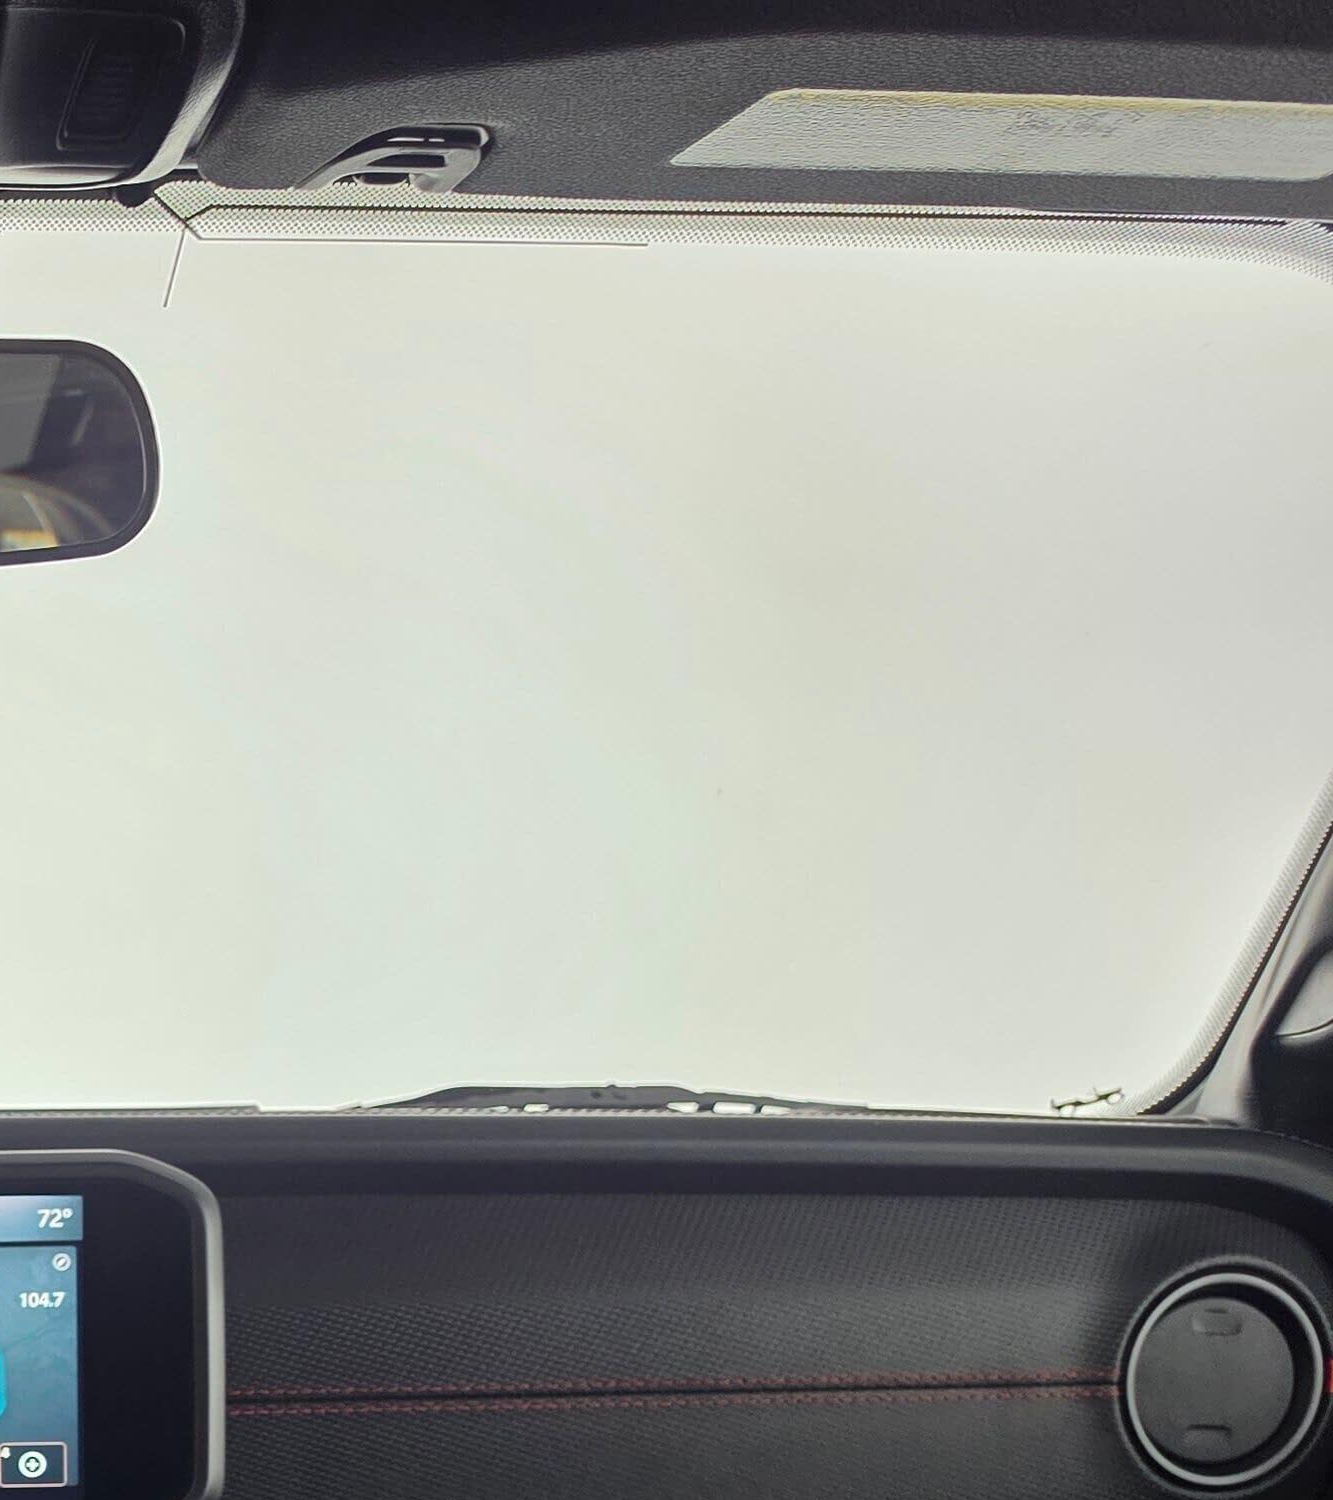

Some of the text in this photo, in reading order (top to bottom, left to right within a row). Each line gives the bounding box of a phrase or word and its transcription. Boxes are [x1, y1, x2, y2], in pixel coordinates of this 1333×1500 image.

[38, 1208, 73, 1229] 72°
[19, 1291, 66, 1309] 104.7
[0, 1446, 12, 1460] 4
